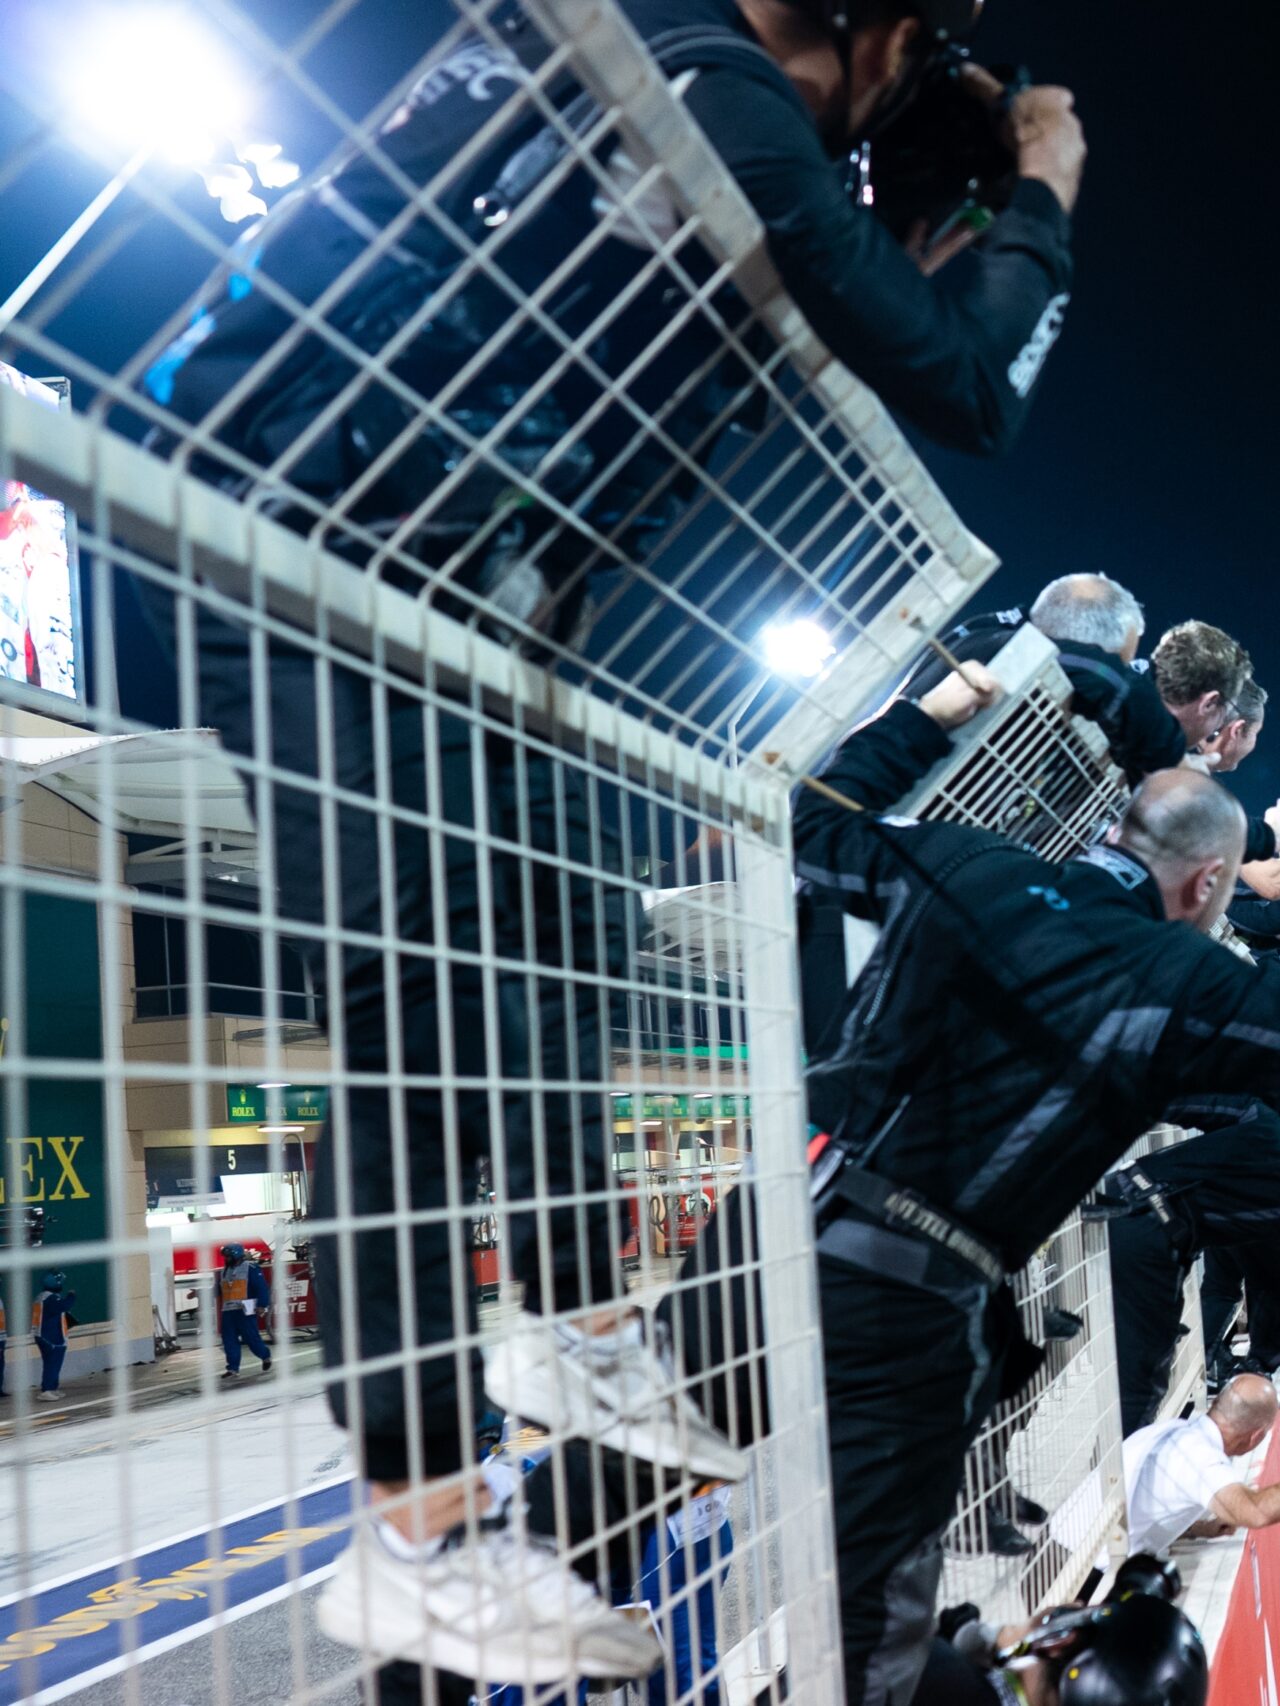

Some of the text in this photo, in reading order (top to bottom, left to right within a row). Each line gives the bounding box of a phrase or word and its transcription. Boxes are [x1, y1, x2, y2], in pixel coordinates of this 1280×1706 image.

[232, 1107, 256, 1116] ROLEX
[297, 1107, 320, 1116] ROLEX
[228, 1150, 236, 1170] 5
[0, 1136, 90, 1203] EX
